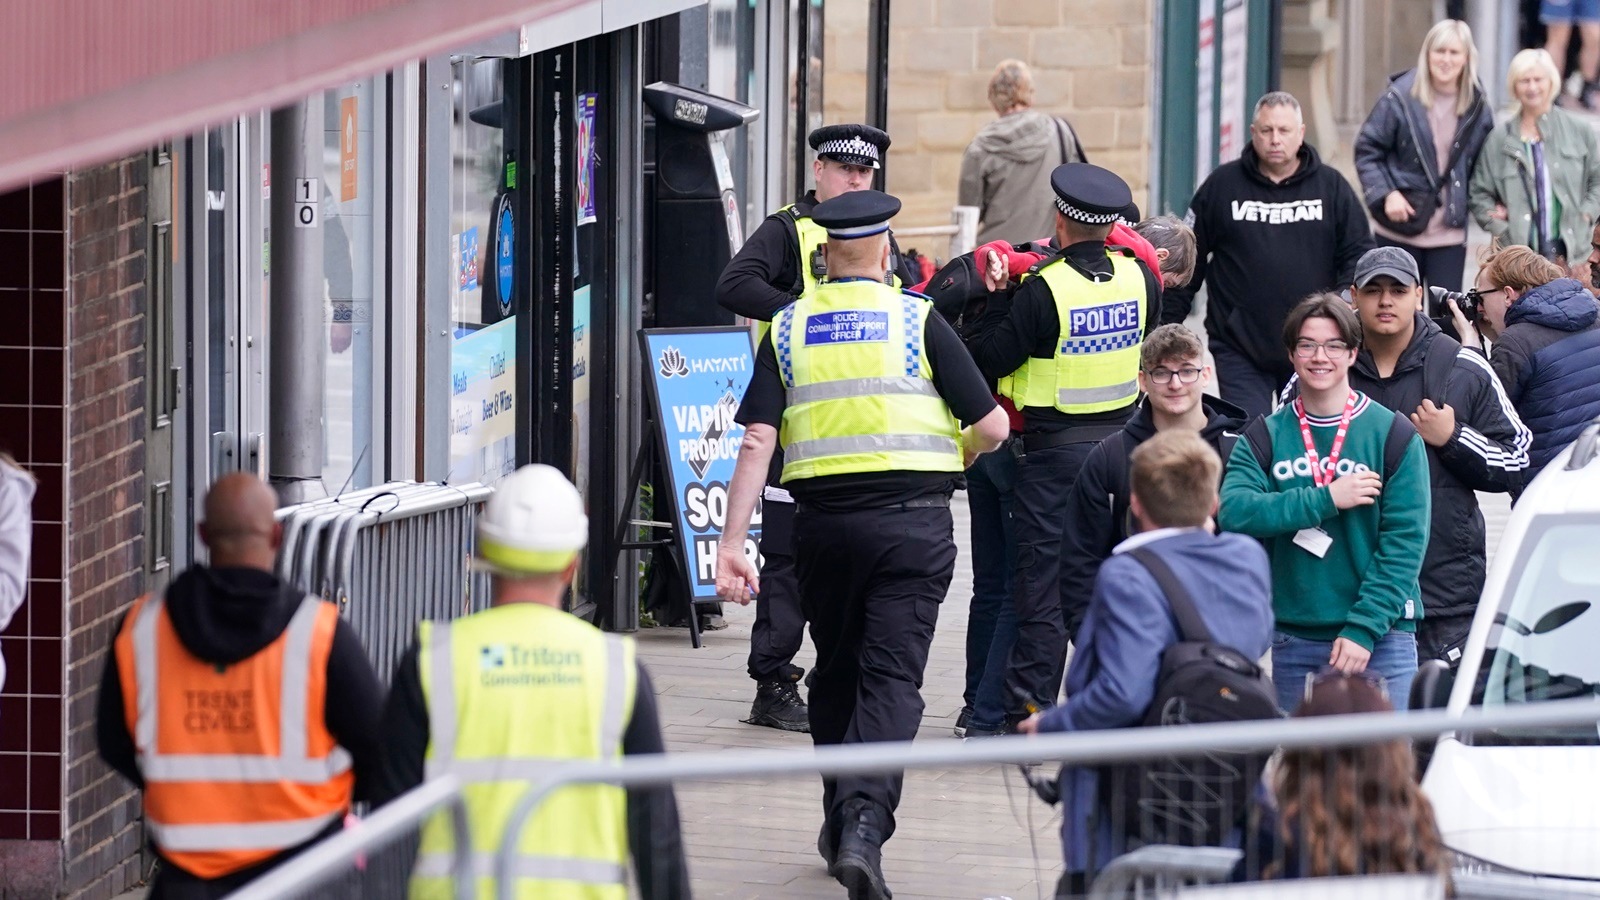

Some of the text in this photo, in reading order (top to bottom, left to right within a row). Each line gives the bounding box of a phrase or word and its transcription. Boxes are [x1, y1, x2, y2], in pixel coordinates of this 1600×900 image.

[1231, 199, 1323, 224] VETERAN
[808, 321, 886, 333] COMMUNITY SUPPORT
[832, 313, 859, 322] POLICE
[1073, 305, 1137, 333] POLICE
[830, 330, 861, 340] OFFICER
[691, 357, 746, 373] HAYATI
[453, 370, 467, 397] Meals
[482, 399, 494, 421] Beer
[500, 390, 512, 411] Wine
[672, 404, 746, 433] VAPIN
[679, 437, 744, 461] PRODUC
[1273, 452, 1371, 480] addas
[511, 645, 582, 666] Triton
[184, 689, 254, 710] TRENT
[183, 711, 255, 734] CIVILS
